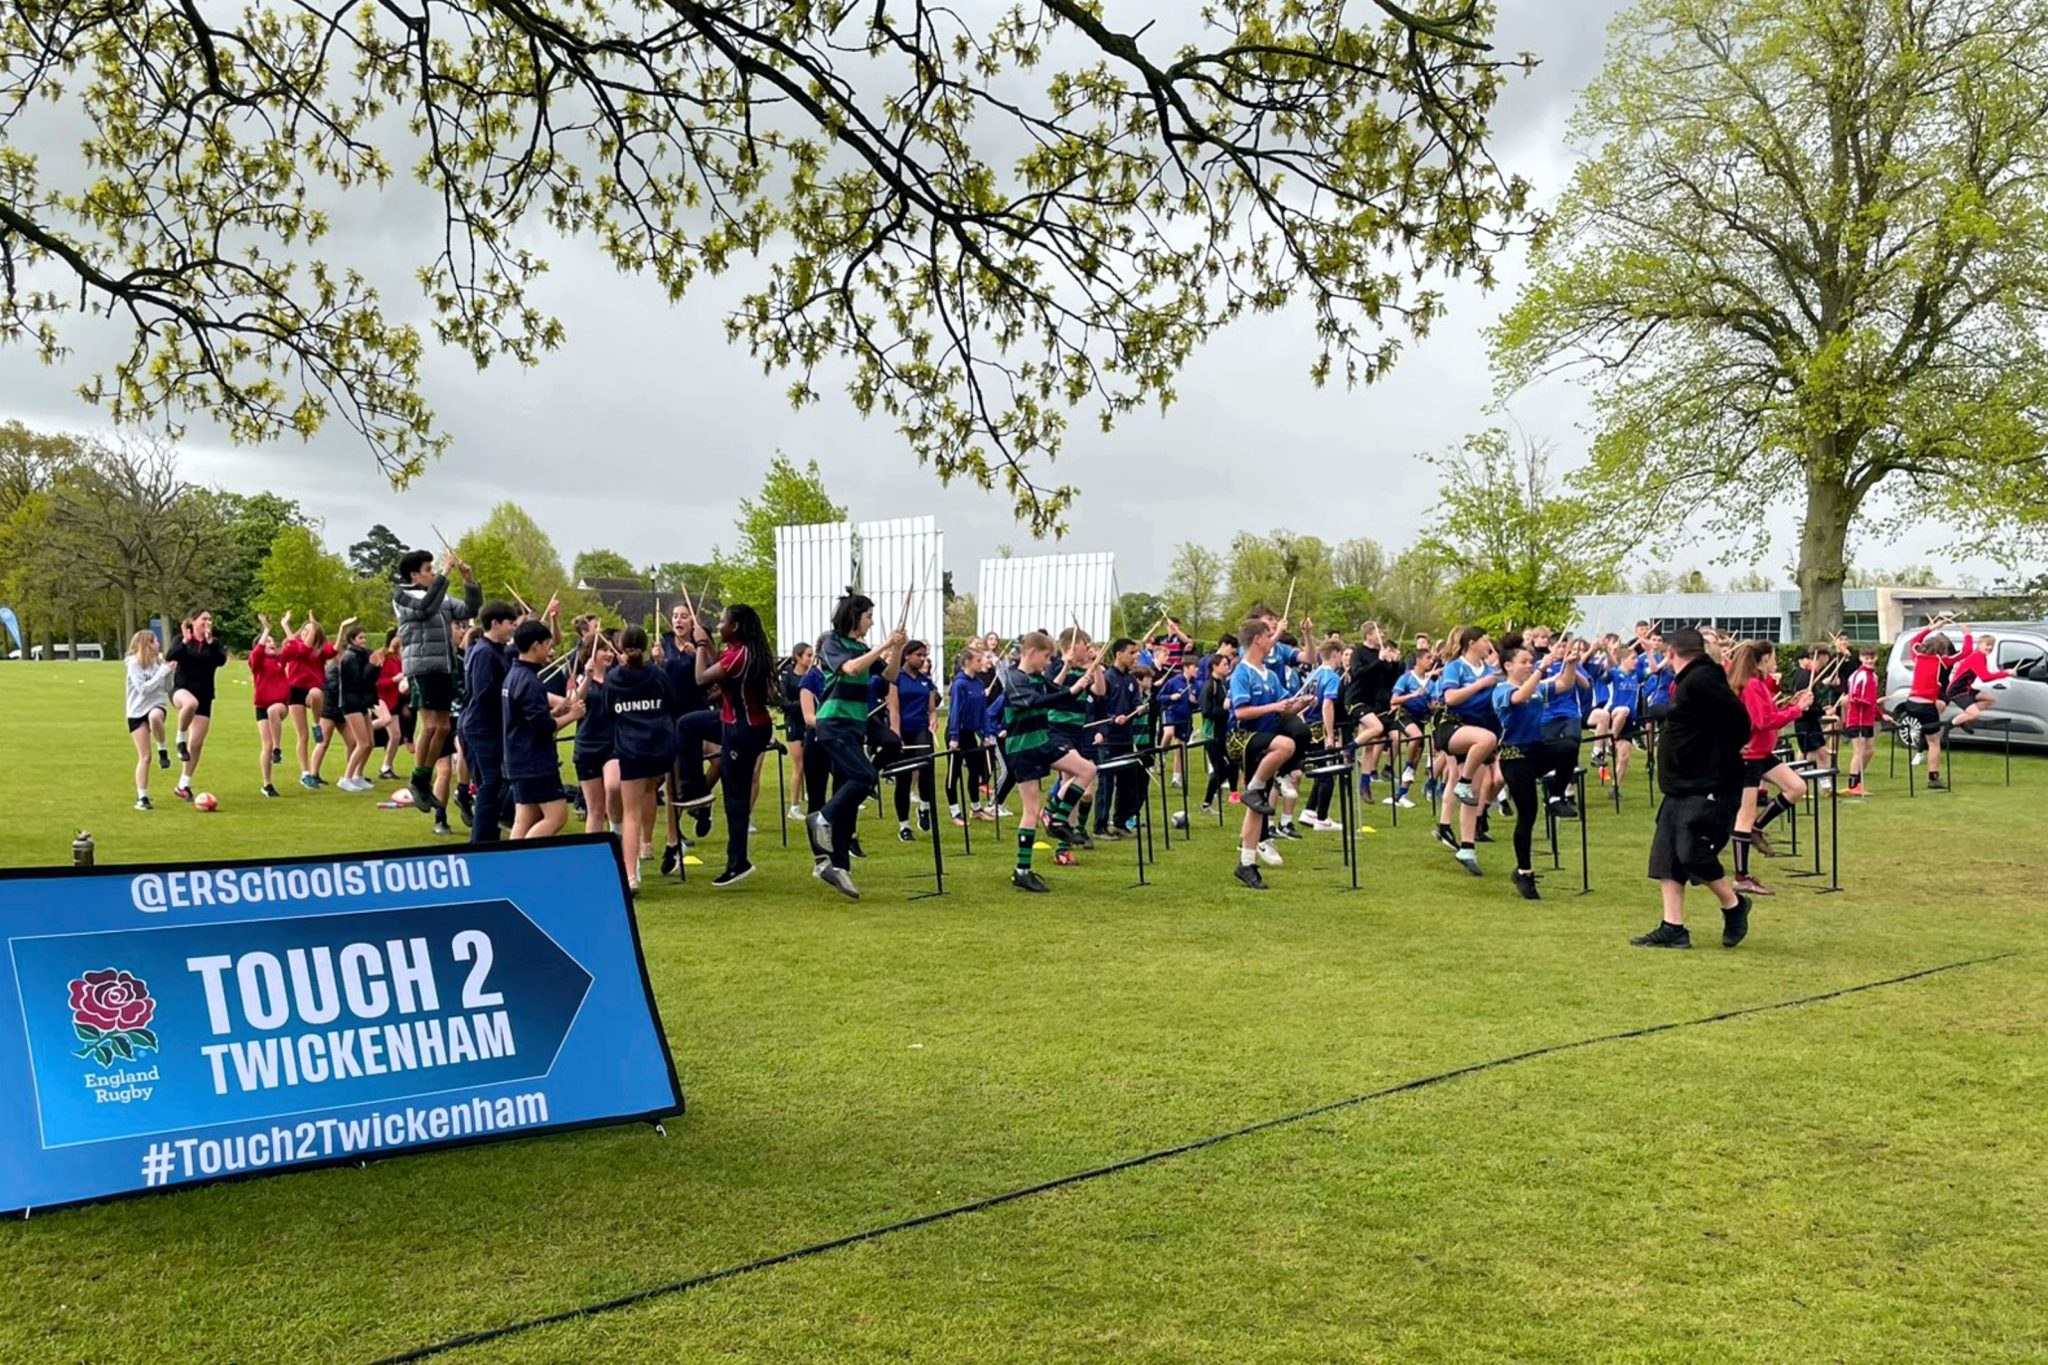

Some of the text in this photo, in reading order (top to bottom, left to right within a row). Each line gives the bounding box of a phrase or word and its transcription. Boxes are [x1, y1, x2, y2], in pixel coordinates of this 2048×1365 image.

[131, 854, 470, 912] @ERSchoolsTouch
[186, 930, 504, 1035] TOUCH 2
[84, 1065, 160, 1088] England
[201, 1010, 516, 1095] TWICKENHAM
[95, 1084, 153, 1103] Rugby
[141, 1091, 549, 1187] #Touch2Twickenham
